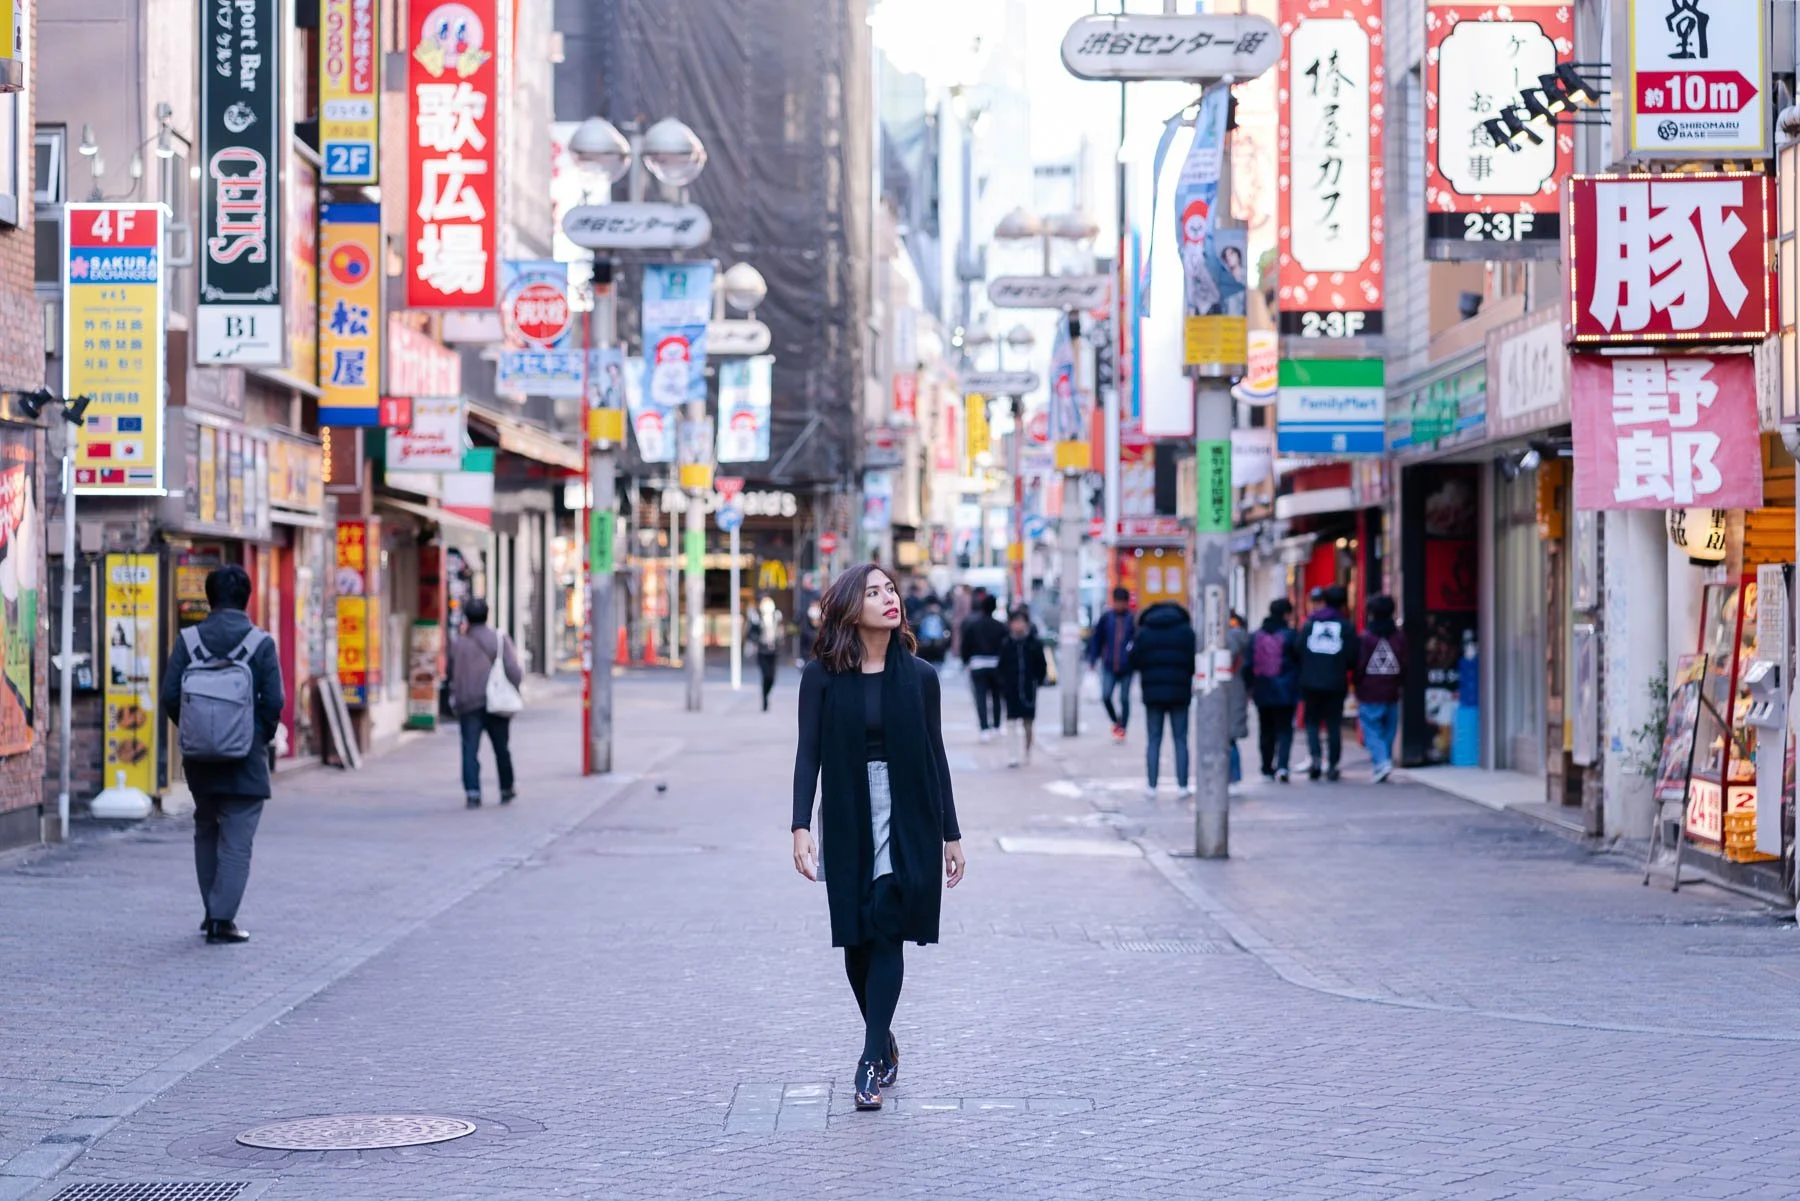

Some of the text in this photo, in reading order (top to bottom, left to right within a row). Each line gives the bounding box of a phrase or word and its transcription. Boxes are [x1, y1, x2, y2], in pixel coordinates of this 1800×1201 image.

[1078, 31, 1269, 55] 渋谷センター街
[240, 53, 262, 92] Bar
[1644, 75, 1739, 111] 約10m
[1680, 121, 1740, 130] SHIROMARU
[331, 150, 368, 173] 2F
[416, 82, 488, 295] 歌広場
[91, 209, 137, 243] 4F
[89, 256, 157, 270] SAKURA
[1589, 180, 1749, 333] 豚
[329, 301, 370, 386] 松屋
[1301, 396, 1377, 411] FamilyMart
[1611, 358, 1723, 504] 野郎
[1689, 785, 1706, 829] 24
